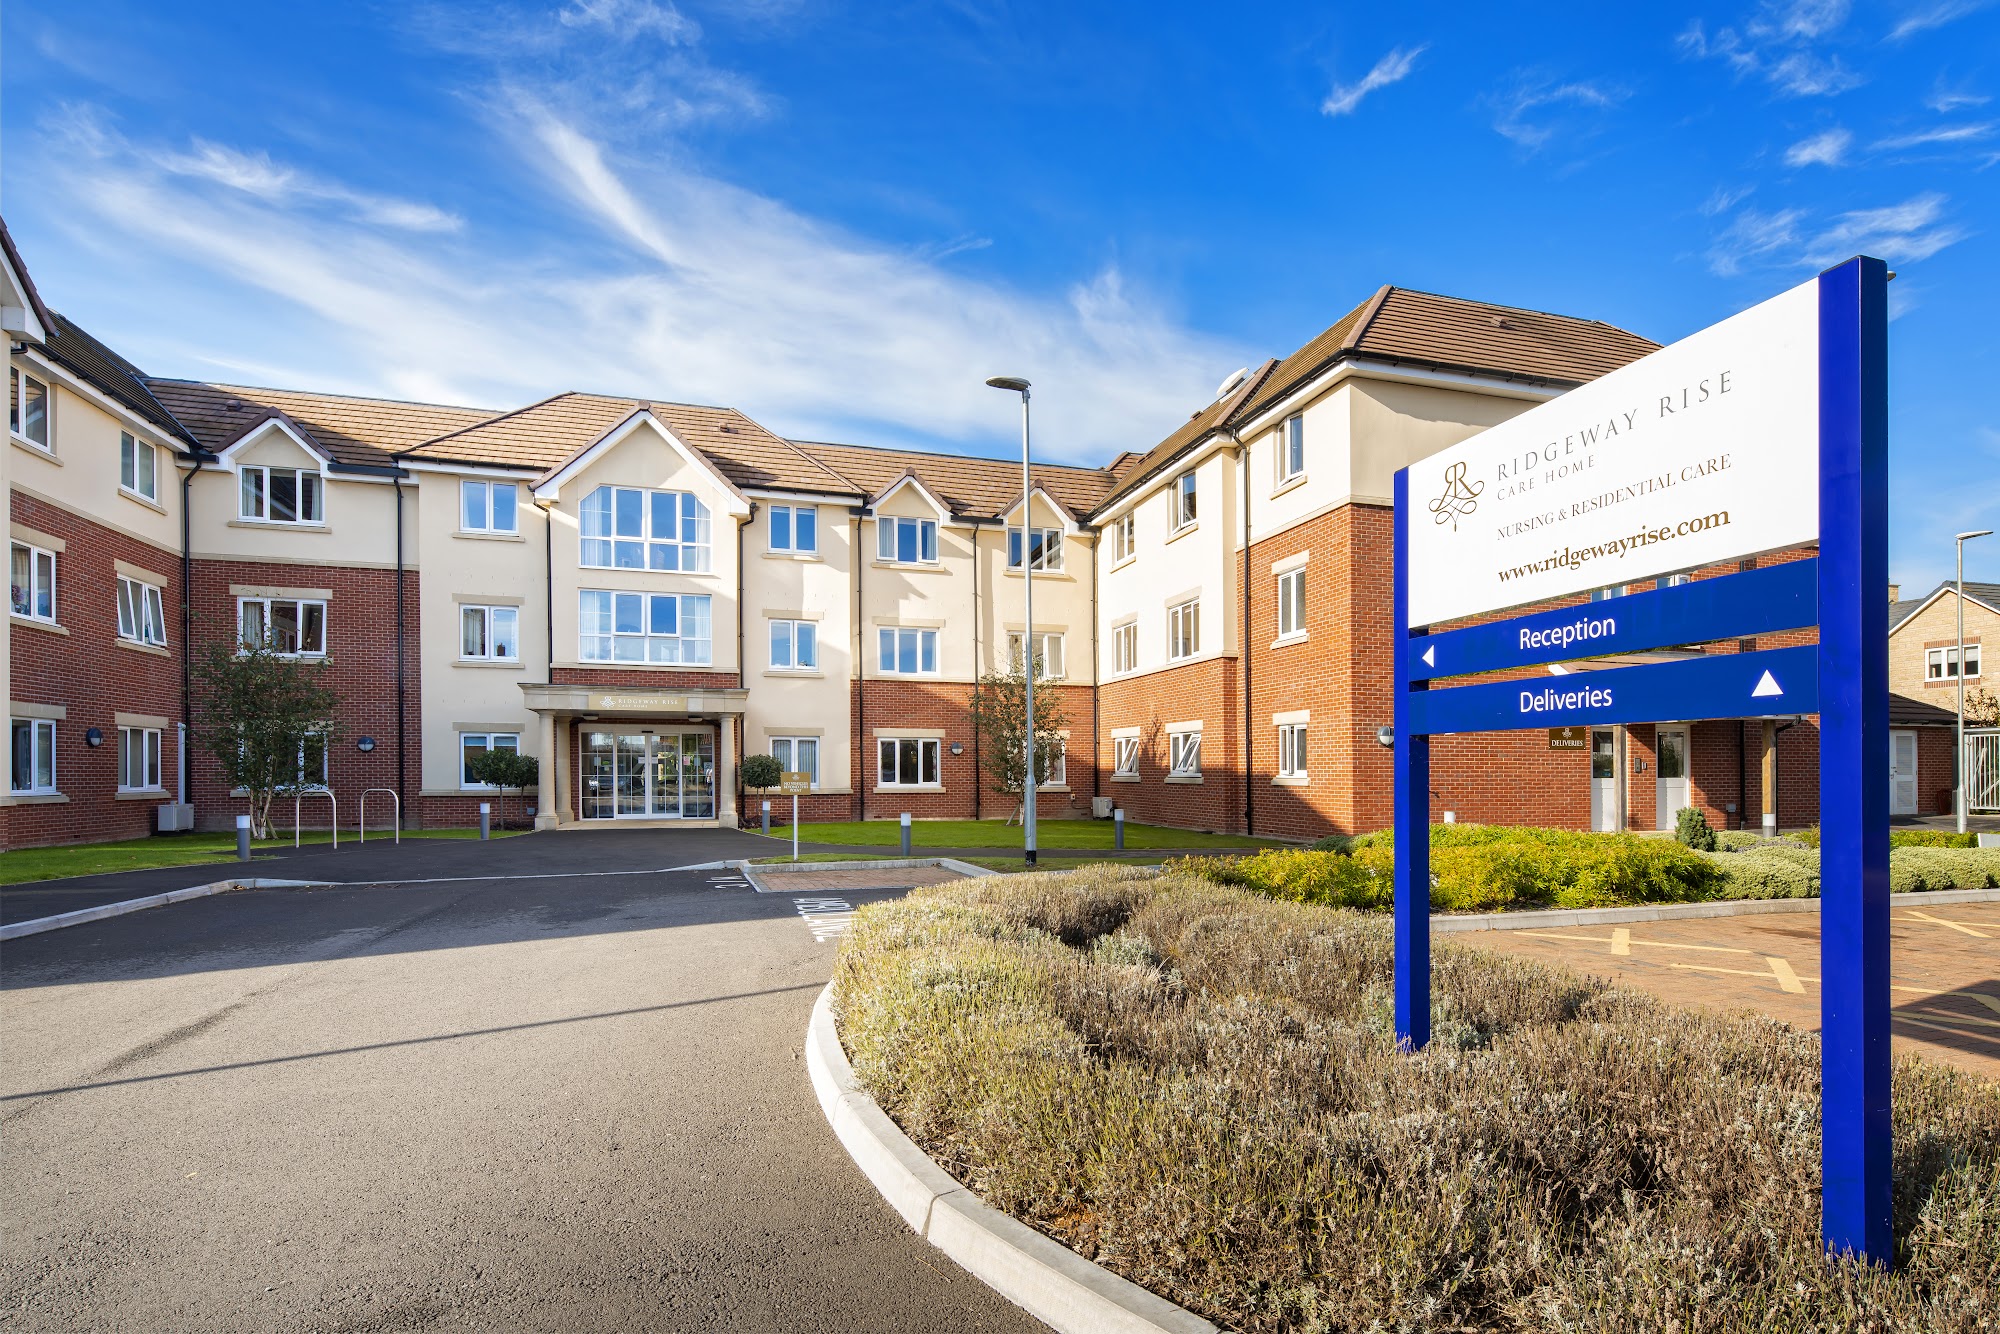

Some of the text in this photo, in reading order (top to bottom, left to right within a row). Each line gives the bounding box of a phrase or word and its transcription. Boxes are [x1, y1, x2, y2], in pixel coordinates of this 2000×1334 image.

[1497, 370, 1732, 481] RIDGEWAY RISE
[1497, 454, 1596, 501] CARE HOME
[1497, 453, 1732, 541] NURSING & RESIDENTIAL CARE
[1498, 510, 1731, 583] www.ridgewayrise.com
[1520, 617, 1616, 650] Reception
[1520, 685, 1613, 713] Deliveries
[1551, 739, 1584, 747] DELIVERIES
